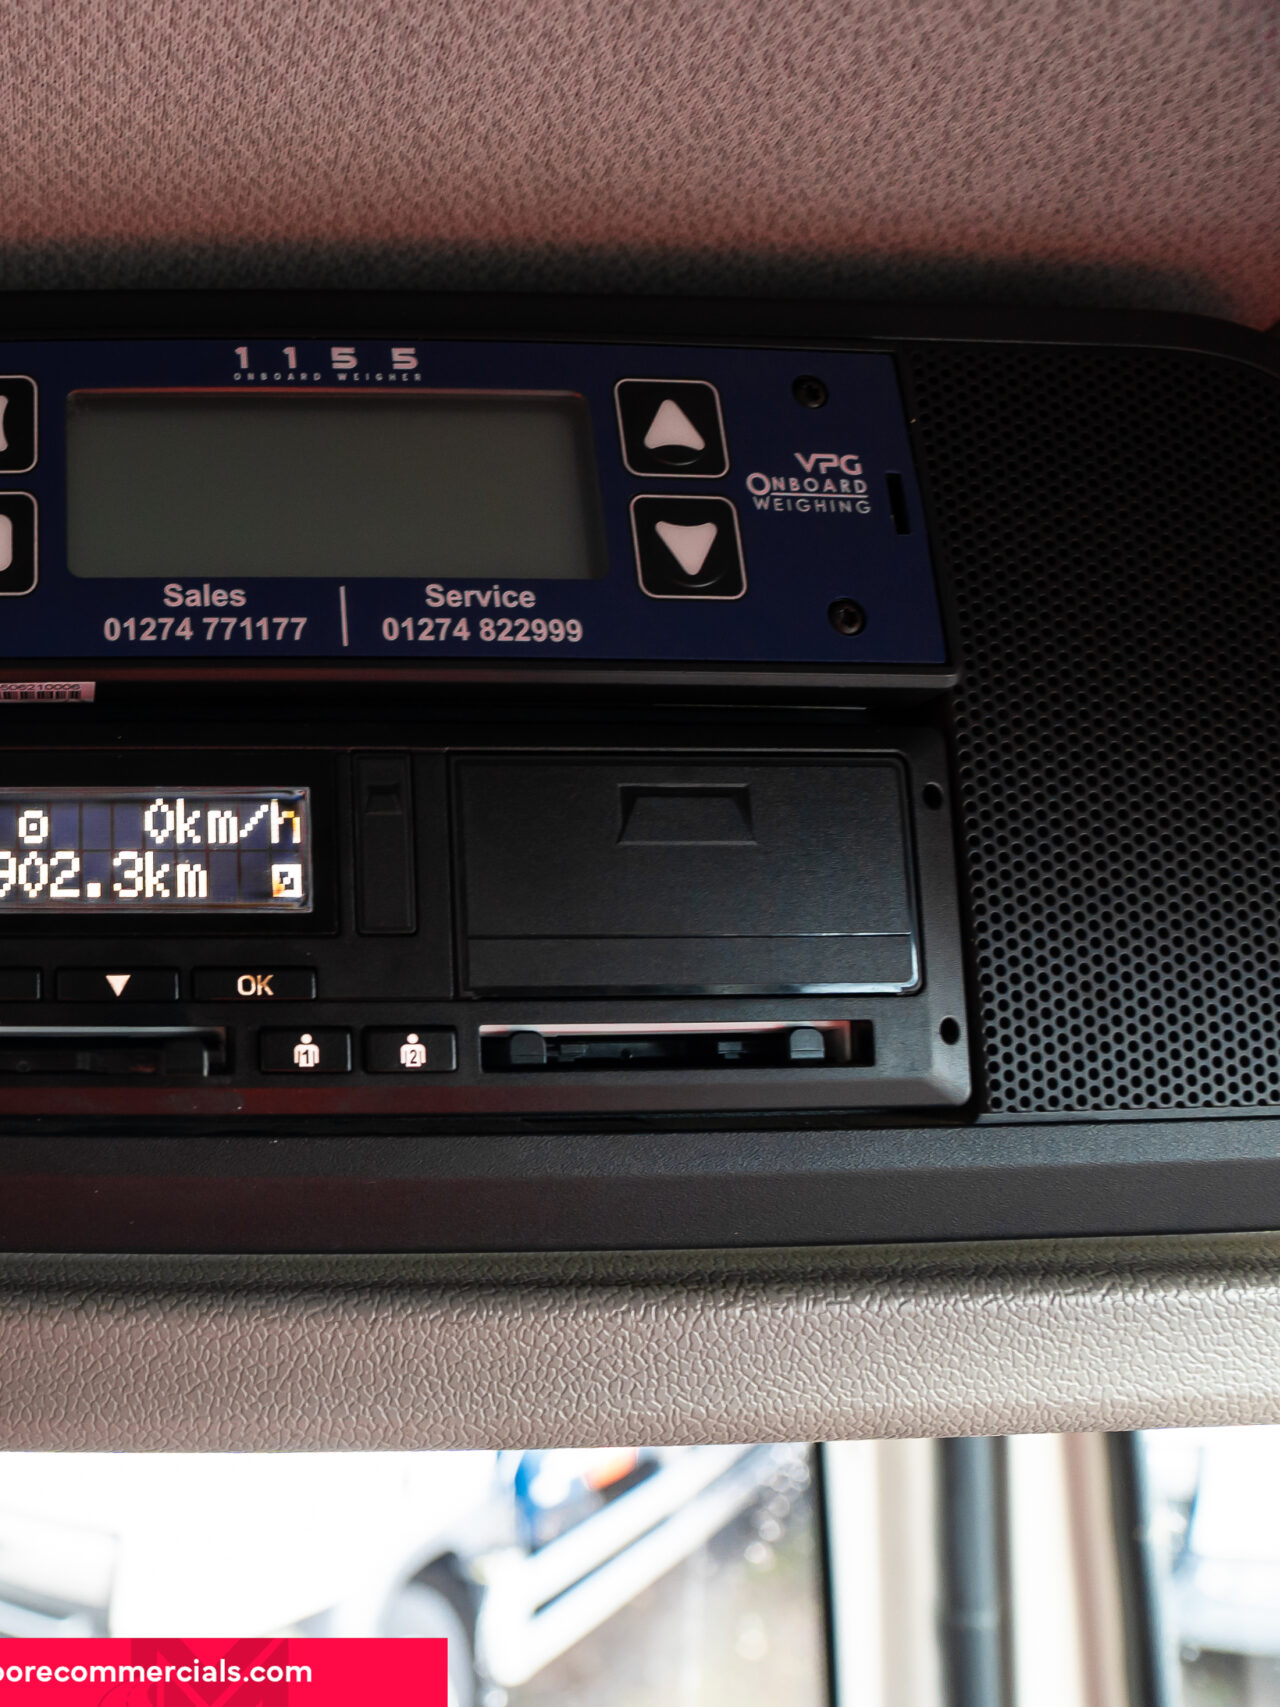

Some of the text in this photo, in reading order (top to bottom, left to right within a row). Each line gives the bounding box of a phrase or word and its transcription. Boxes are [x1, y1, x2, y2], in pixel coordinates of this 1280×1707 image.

[234, 346, 419, 370] 1155
[233, 372, 422, 382] ONBOARD WEIGHER
[793, 452, 863, 476] VPG
[746, 472, 868, 496] ONBOARD
[752, 495, 871, 514] WEIGHING
[163, 583, 247, 608] Sales
[425, 583, 537, 609] Service
[103, 617, 308, 642] 01274 771177
[382, 617, 583, 643] 01274 822999
[144, 798, 301, 844] 0km/h
[236, 974, 275, 996] OK
